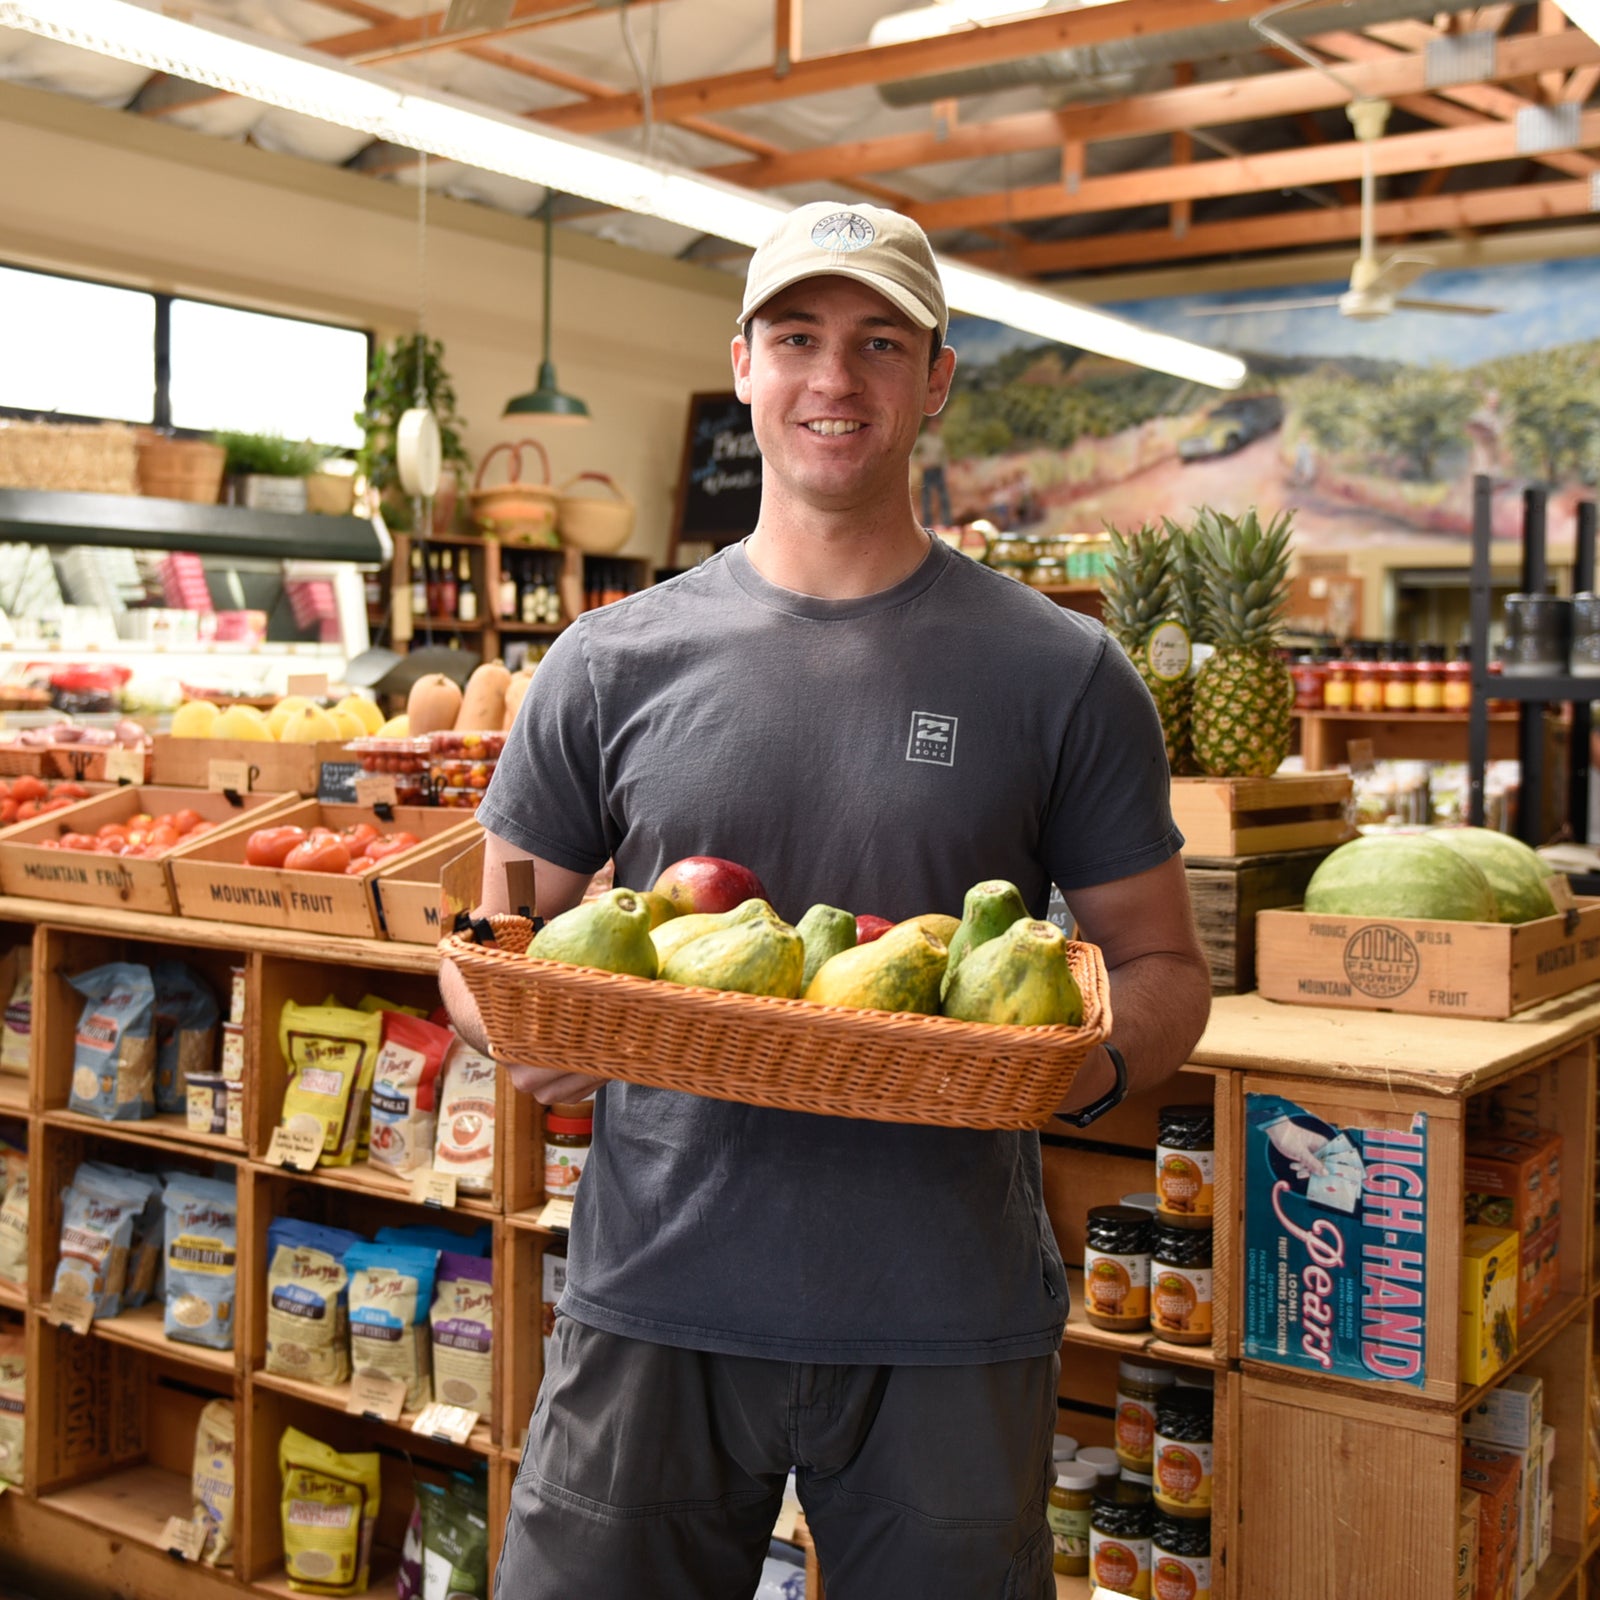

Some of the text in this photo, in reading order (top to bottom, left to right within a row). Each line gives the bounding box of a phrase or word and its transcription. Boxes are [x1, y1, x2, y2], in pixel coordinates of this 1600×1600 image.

[915, 749, 945, 758] BONG
[24, 863, 134, 889] MOUNTAIN FRUIT
[210, 884, 334, 914] MOUNTAIN FRUIT
[1309, 923, 1348, 938] PRODUCE
[1349, 928, 1414, 963] LOOMIS
[1348, 960, 1415, 974] FRUIT
[1351, 972, 1411, 984] GROWERS
[1298, 979, 1469, 1007] MOUNTAIN FRUIT
[1258, 1249, 1266, 1285] PACKERS
[1271, 1180, 1346, 1370] Pears
[1248, 1284, 1256, 1332] CALIFORNIA
[1277, 1236, 1287, 1356] FRUIT GROWERS ASSOCIATION
[1288, 1273, 1298, 1322] LOOMIS
[1258, 1296, 1266, 1334] SHIPPERS
